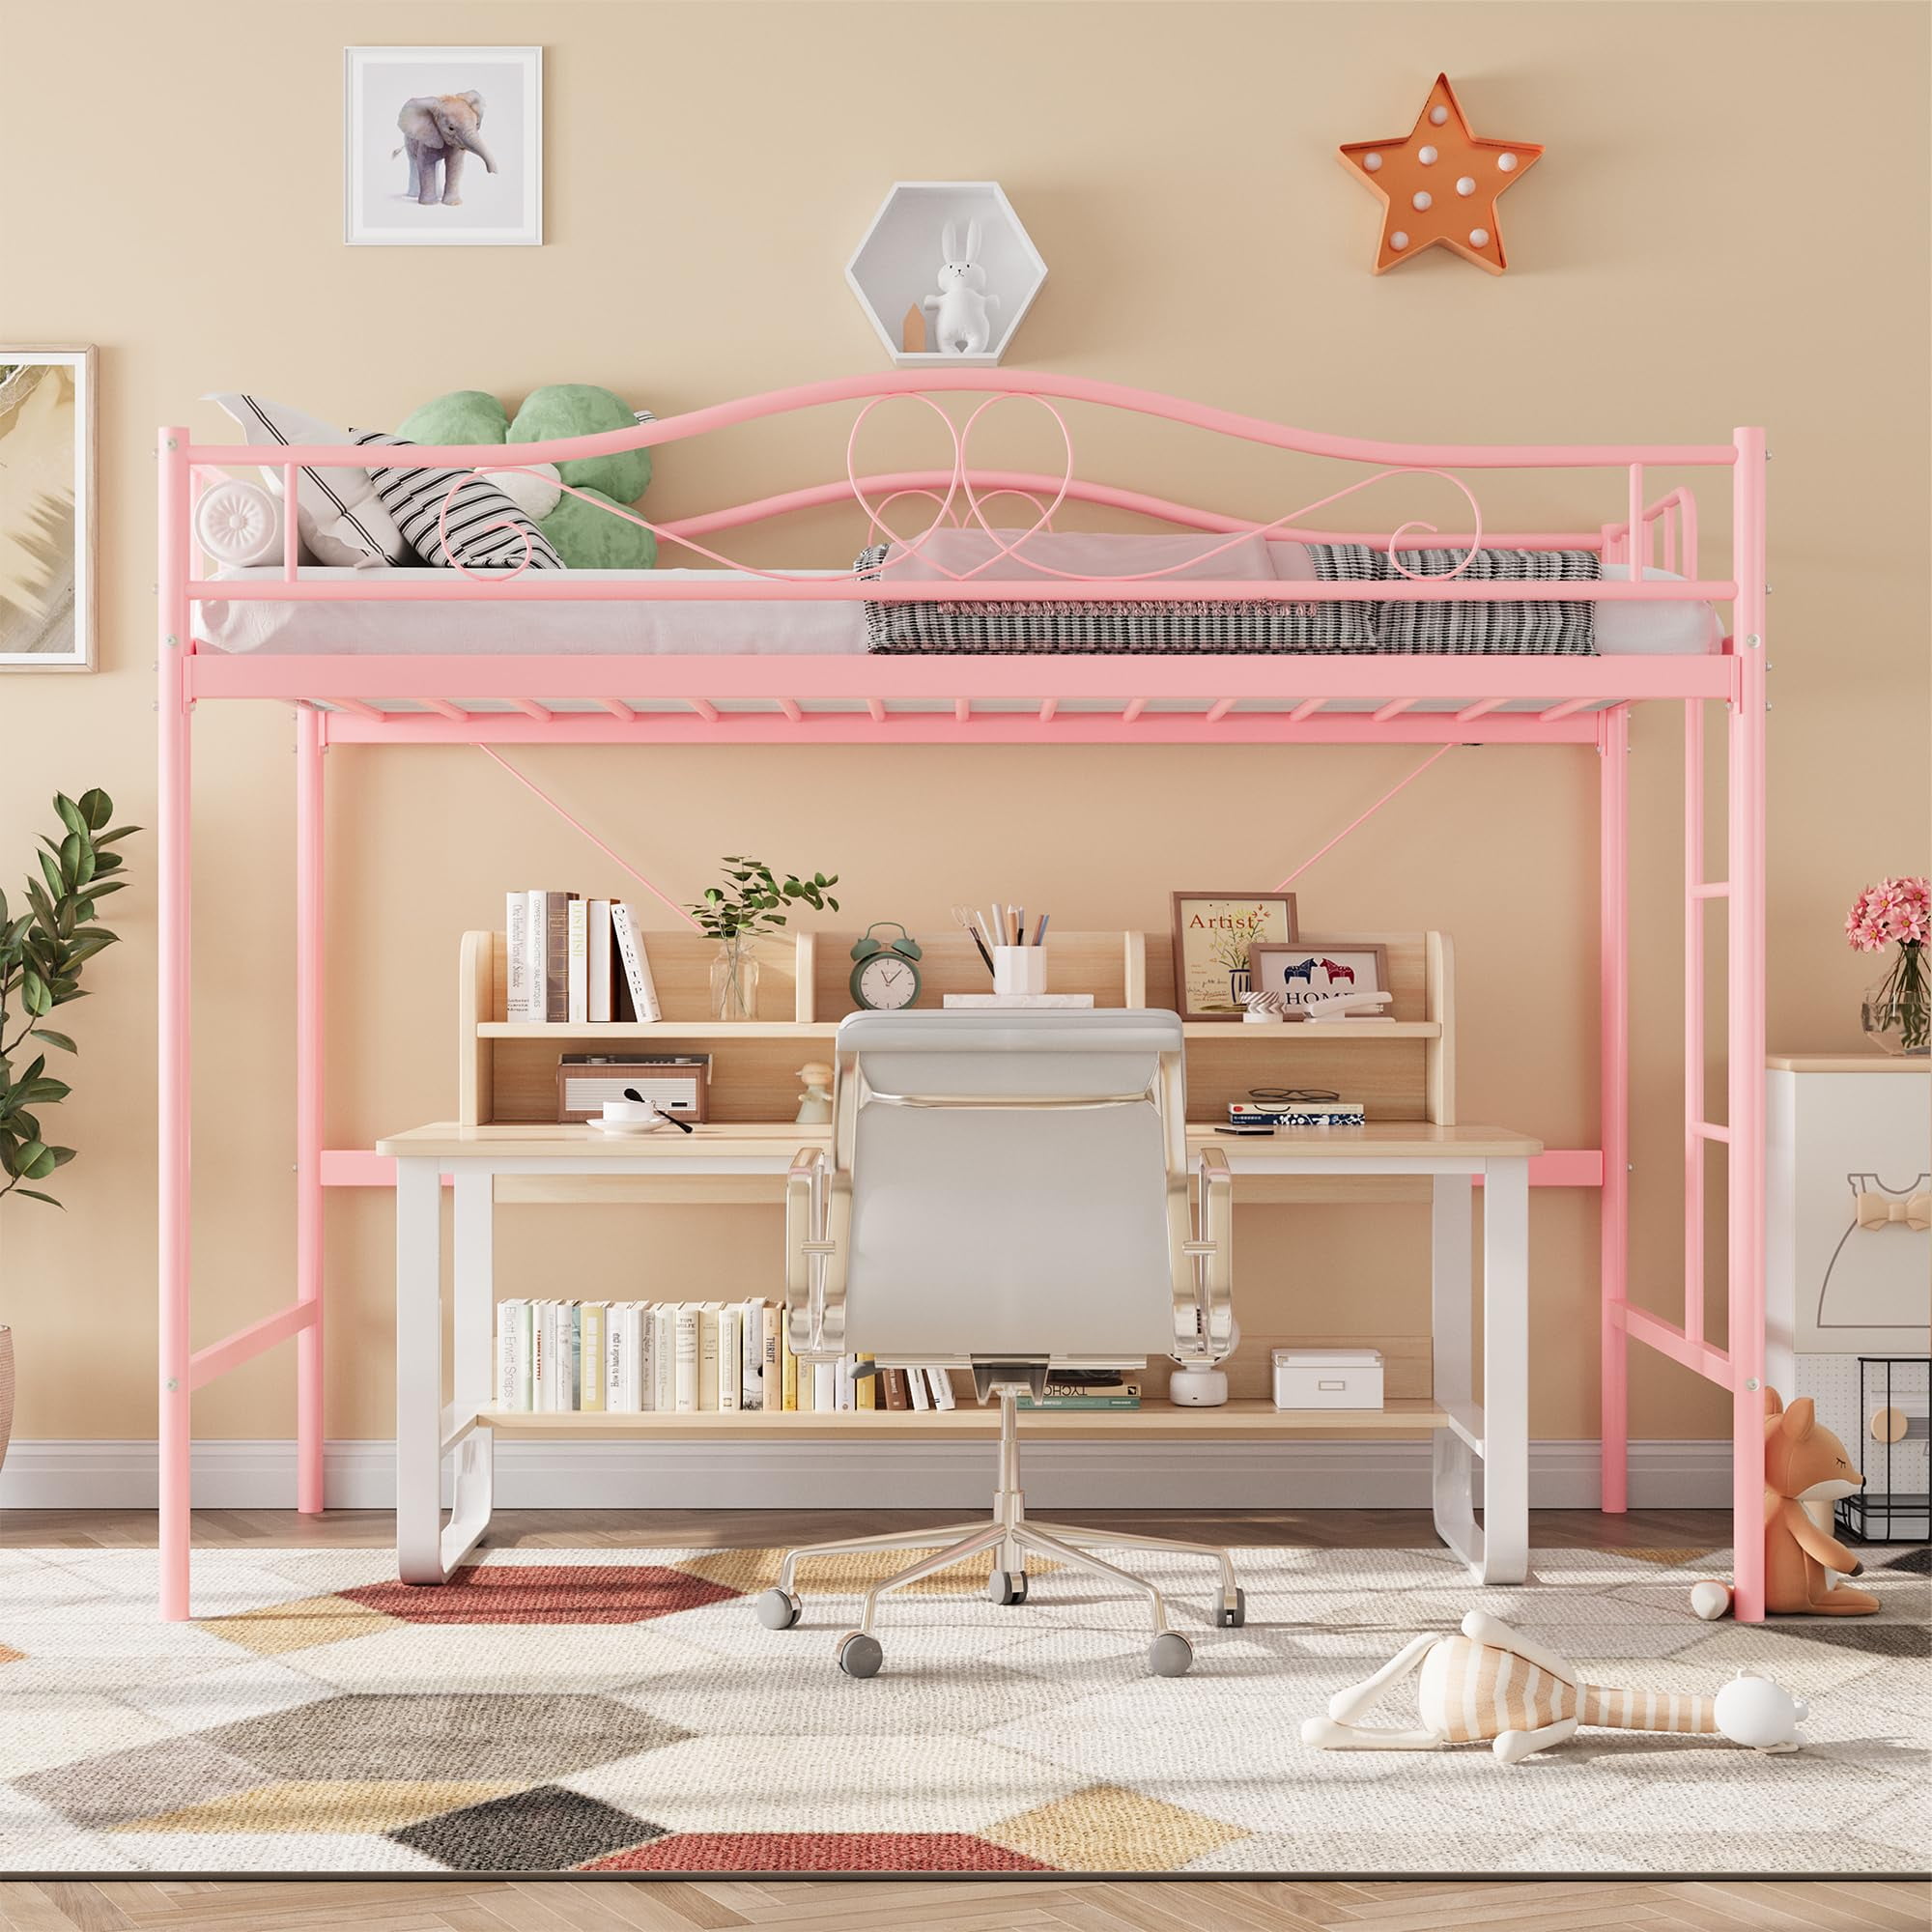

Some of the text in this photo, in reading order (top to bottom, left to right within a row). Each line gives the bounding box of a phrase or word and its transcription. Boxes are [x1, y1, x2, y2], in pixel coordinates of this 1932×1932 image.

[1189, 914, 1255, 929] Artist
[1286, 991, 1355, 1006] HO
[765, 1337, 776, 1364] THRIFT
[502, 1366, 517, 1398] Snaps
